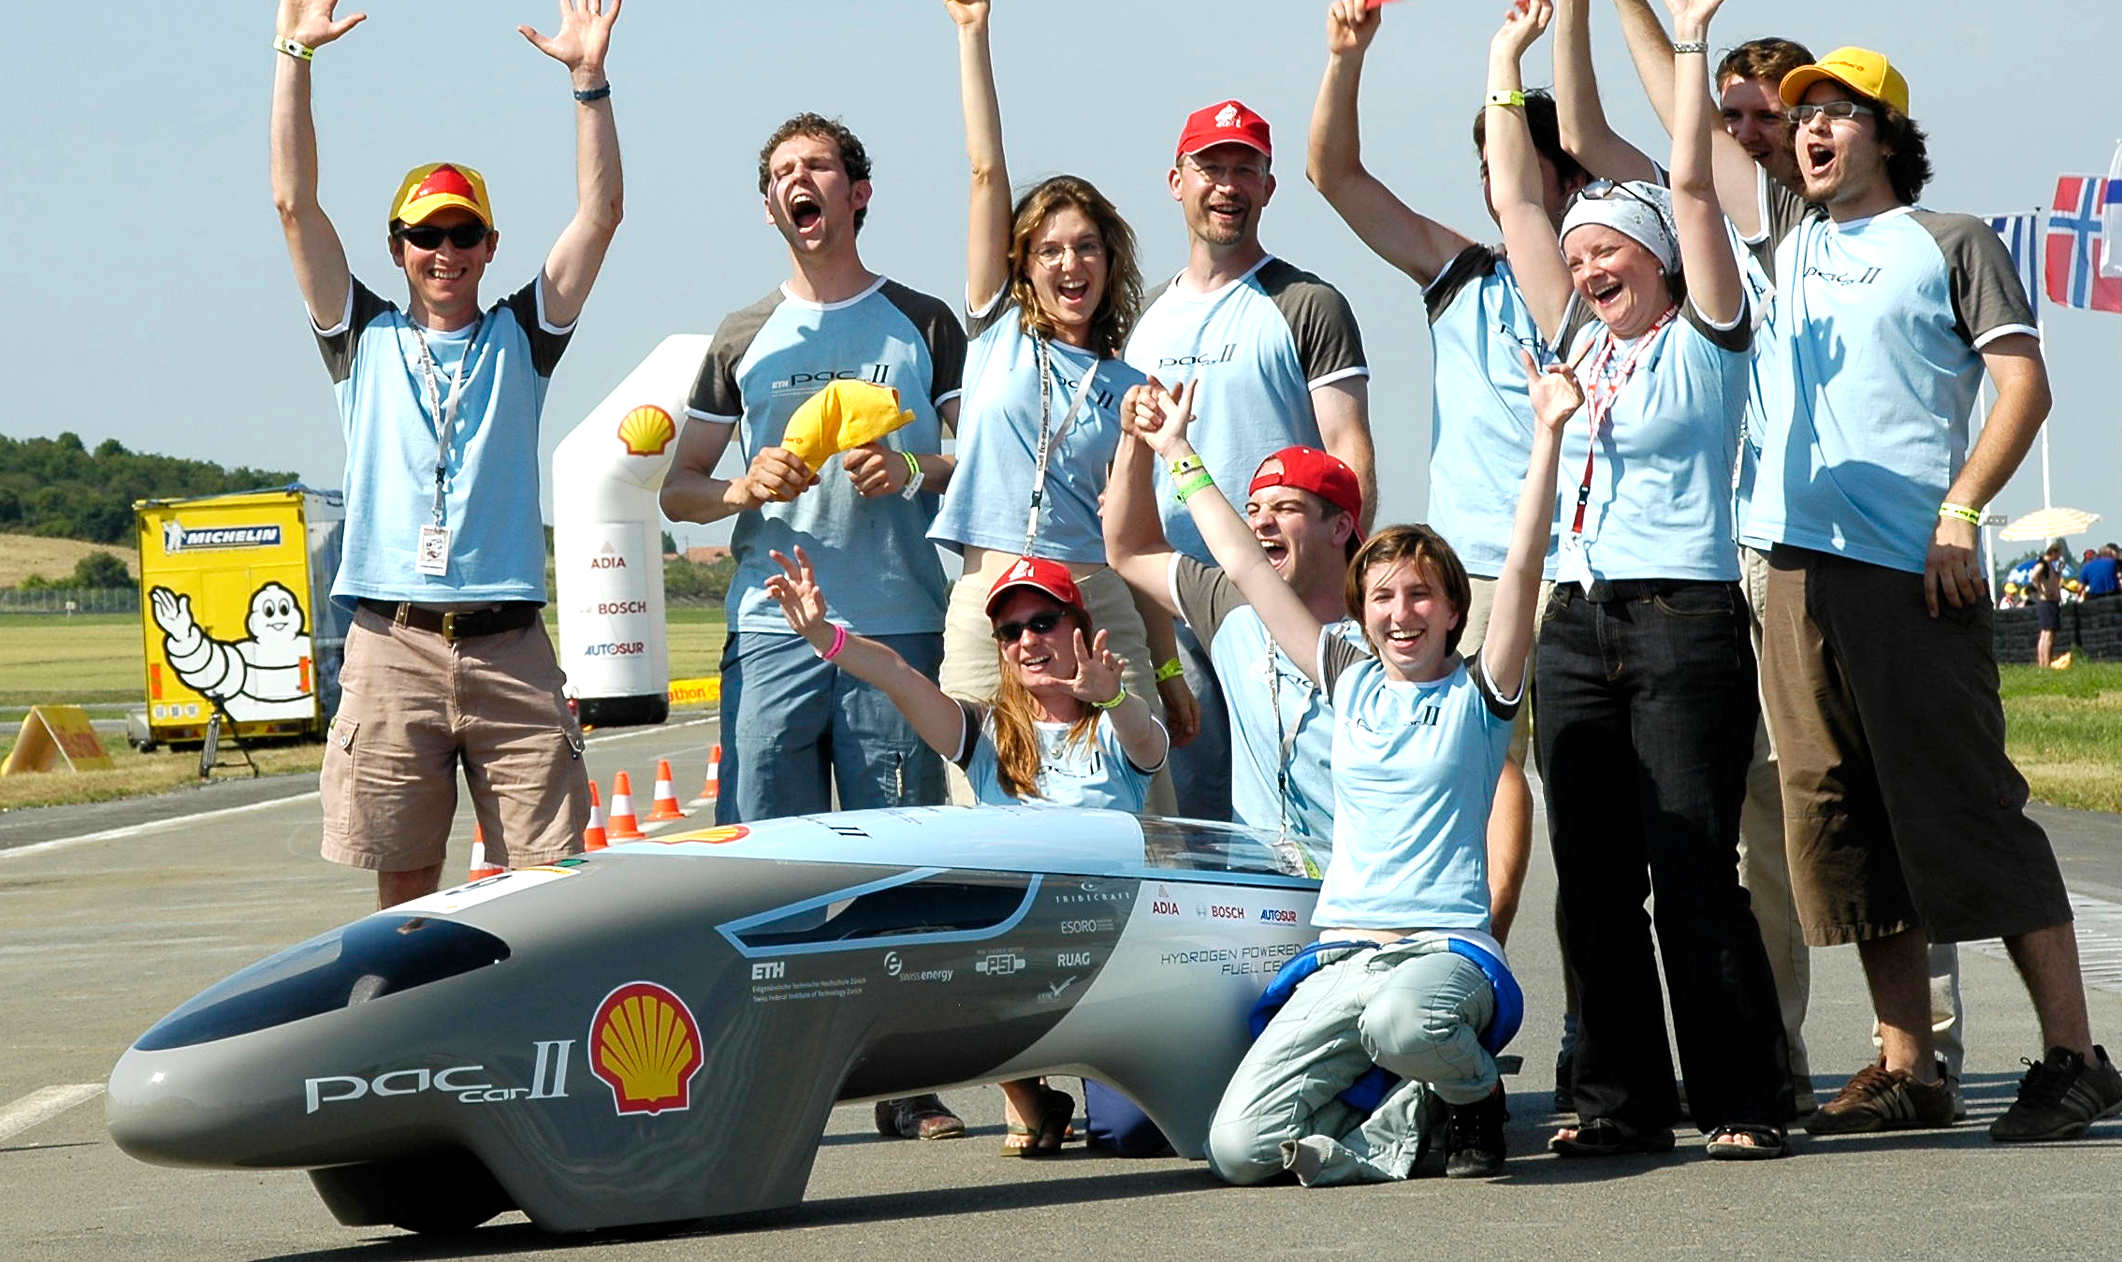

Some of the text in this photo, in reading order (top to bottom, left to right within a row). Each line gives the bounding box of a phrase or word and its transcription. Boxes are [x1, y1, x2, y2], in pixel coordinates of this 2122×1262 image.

[790, 370, 857, 387] pac
[871, 364, 889, 384] II
[187, 529, 277, 544] MICHELIN
[590, 556, 627, 569] ADIA
[598, 601, 647, 615] BOSCH
[584, 642, 645, 657] AUTOSUR
[1152, 901, 1180, 916] ADIA
[1211, 905, 1245, 919] BOSCH
[1260, 909, 1297, 922] AUTOSUR
[1060, 919, 1097, 934] ESORO
[1057, 952, 1090, 967] RUAG
[1161, 943, 1304, 965] HYDROGEN POWERED
[751, 961, 785, 980] ETH
[986, 953, 1016, 976] PSI
[1221, 960, 1285, 976] FUEL CE
[305, 1039, 577, 1114] pac car II
